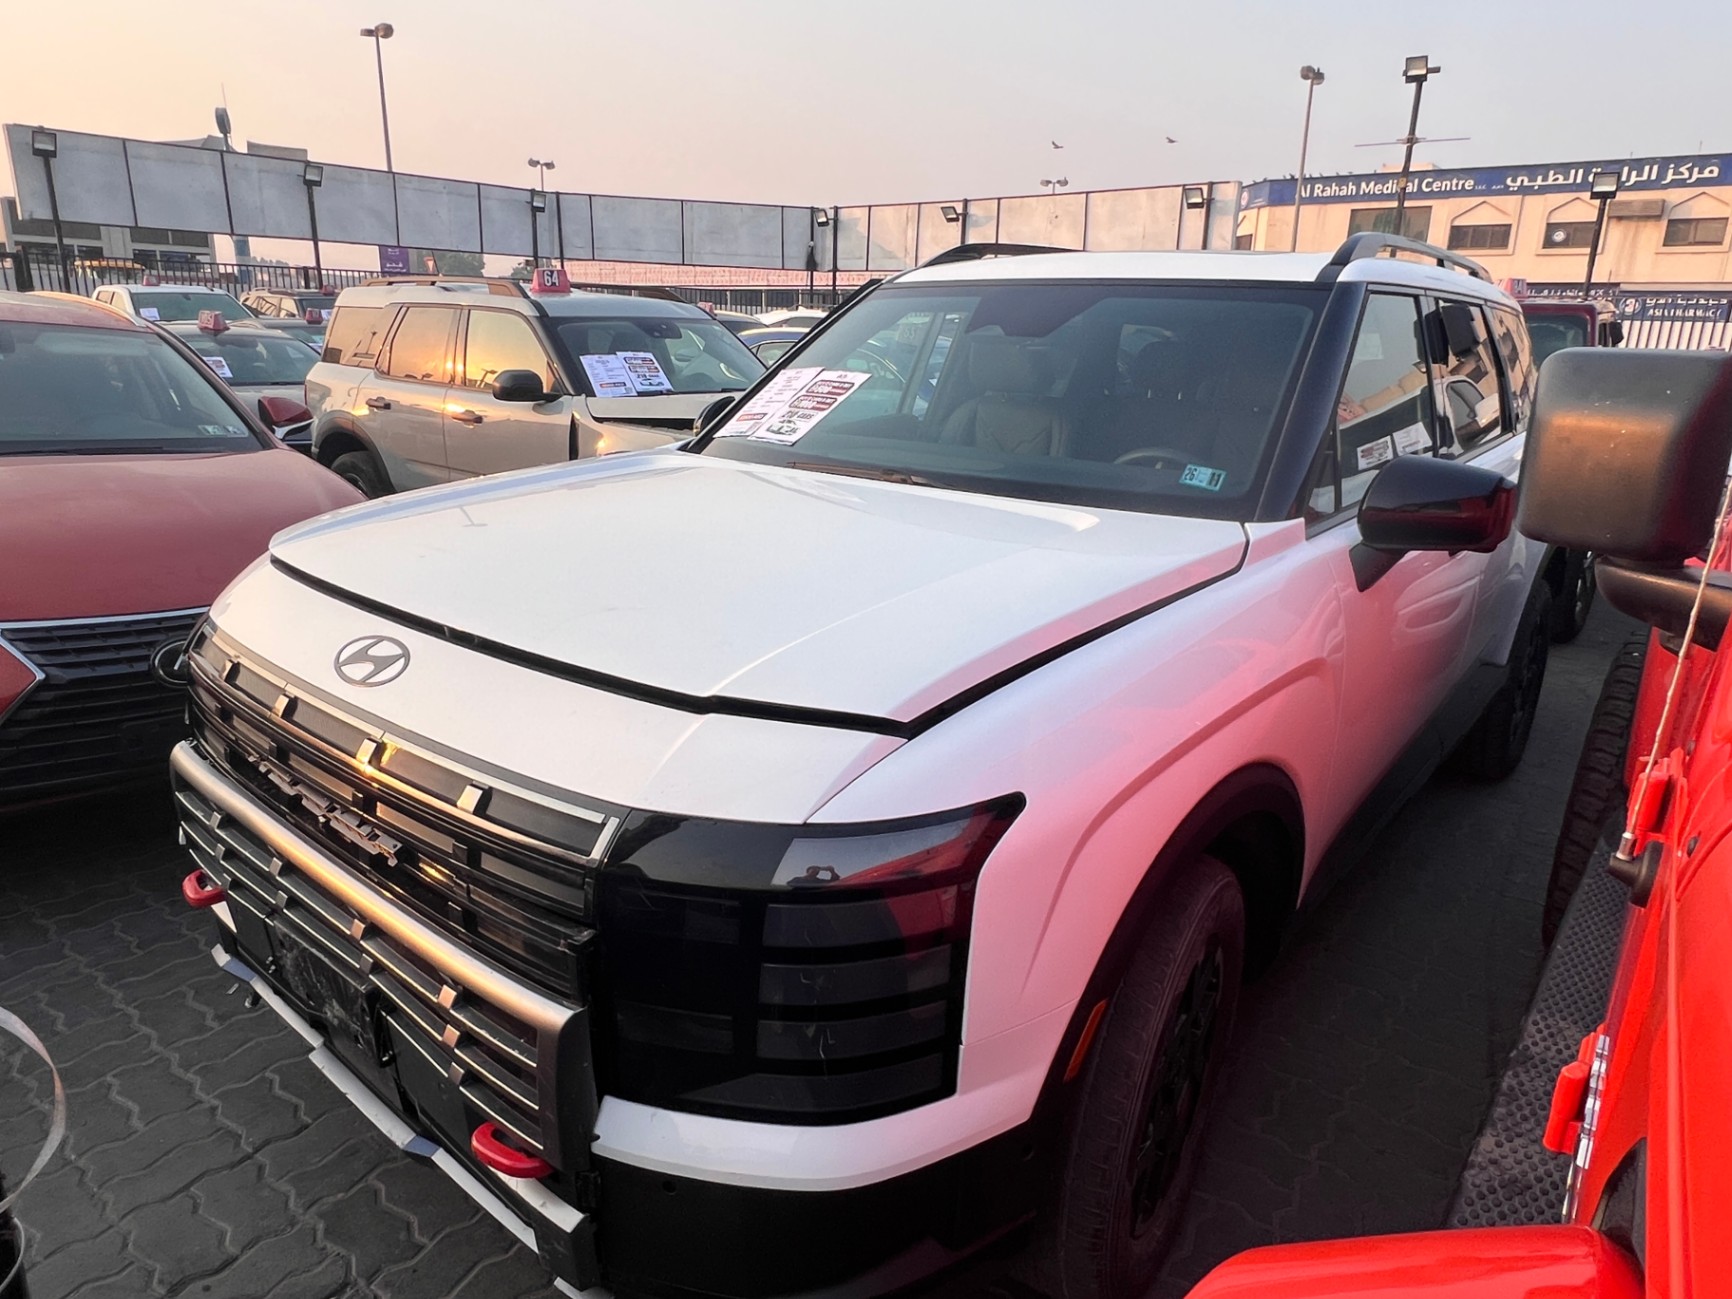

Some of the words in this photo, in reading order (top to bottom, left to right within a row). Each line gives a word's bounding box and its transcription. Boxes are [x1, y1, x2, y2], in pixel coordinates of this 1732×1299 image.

[1506, 168, 1584, 191] الطبي
[1588, 164, 1659, 187] الراة
[1661, 161, 1720, 185] مركز
[1313, 182, 1356, 198] Rahah
[1421, 176, 1475, 193] Centre
[543, 270, 559, 287] 64
[1183, 467, 1198, 482] 26
[1208, 471, 1223, 488] 11
